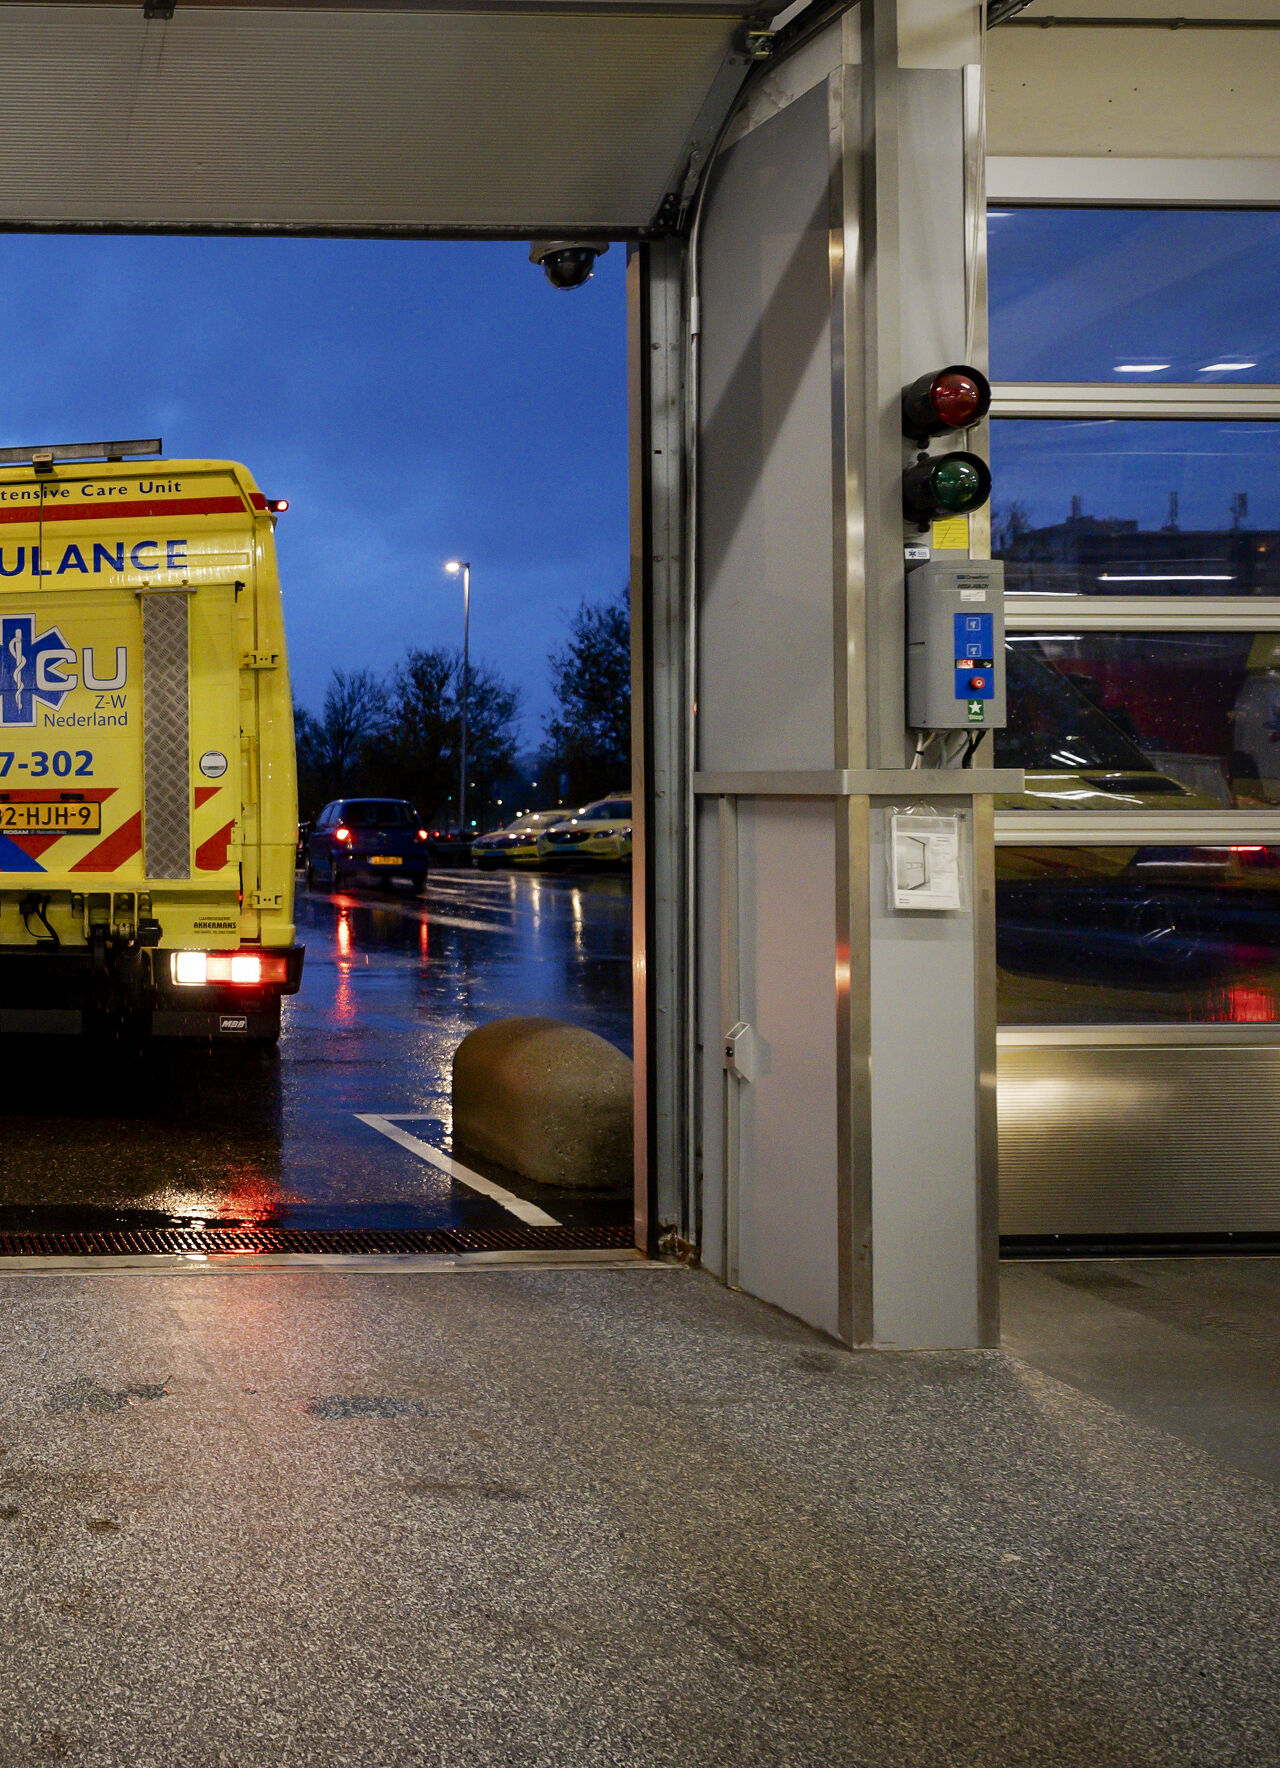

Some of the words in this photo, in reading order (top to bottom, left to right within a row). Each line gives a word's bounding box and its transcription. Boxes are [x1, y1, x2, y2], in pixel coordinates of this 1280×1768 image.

[81, 484, 128, 497] Care
[139, 480, 182, 494] Unit
[94, 695, 127, 709] Z-W
[44, 711, 128, 728] Nederland
[193, 921, 237, 929] AKKERMANS
[222, 1020, 246, 1028] MBB
